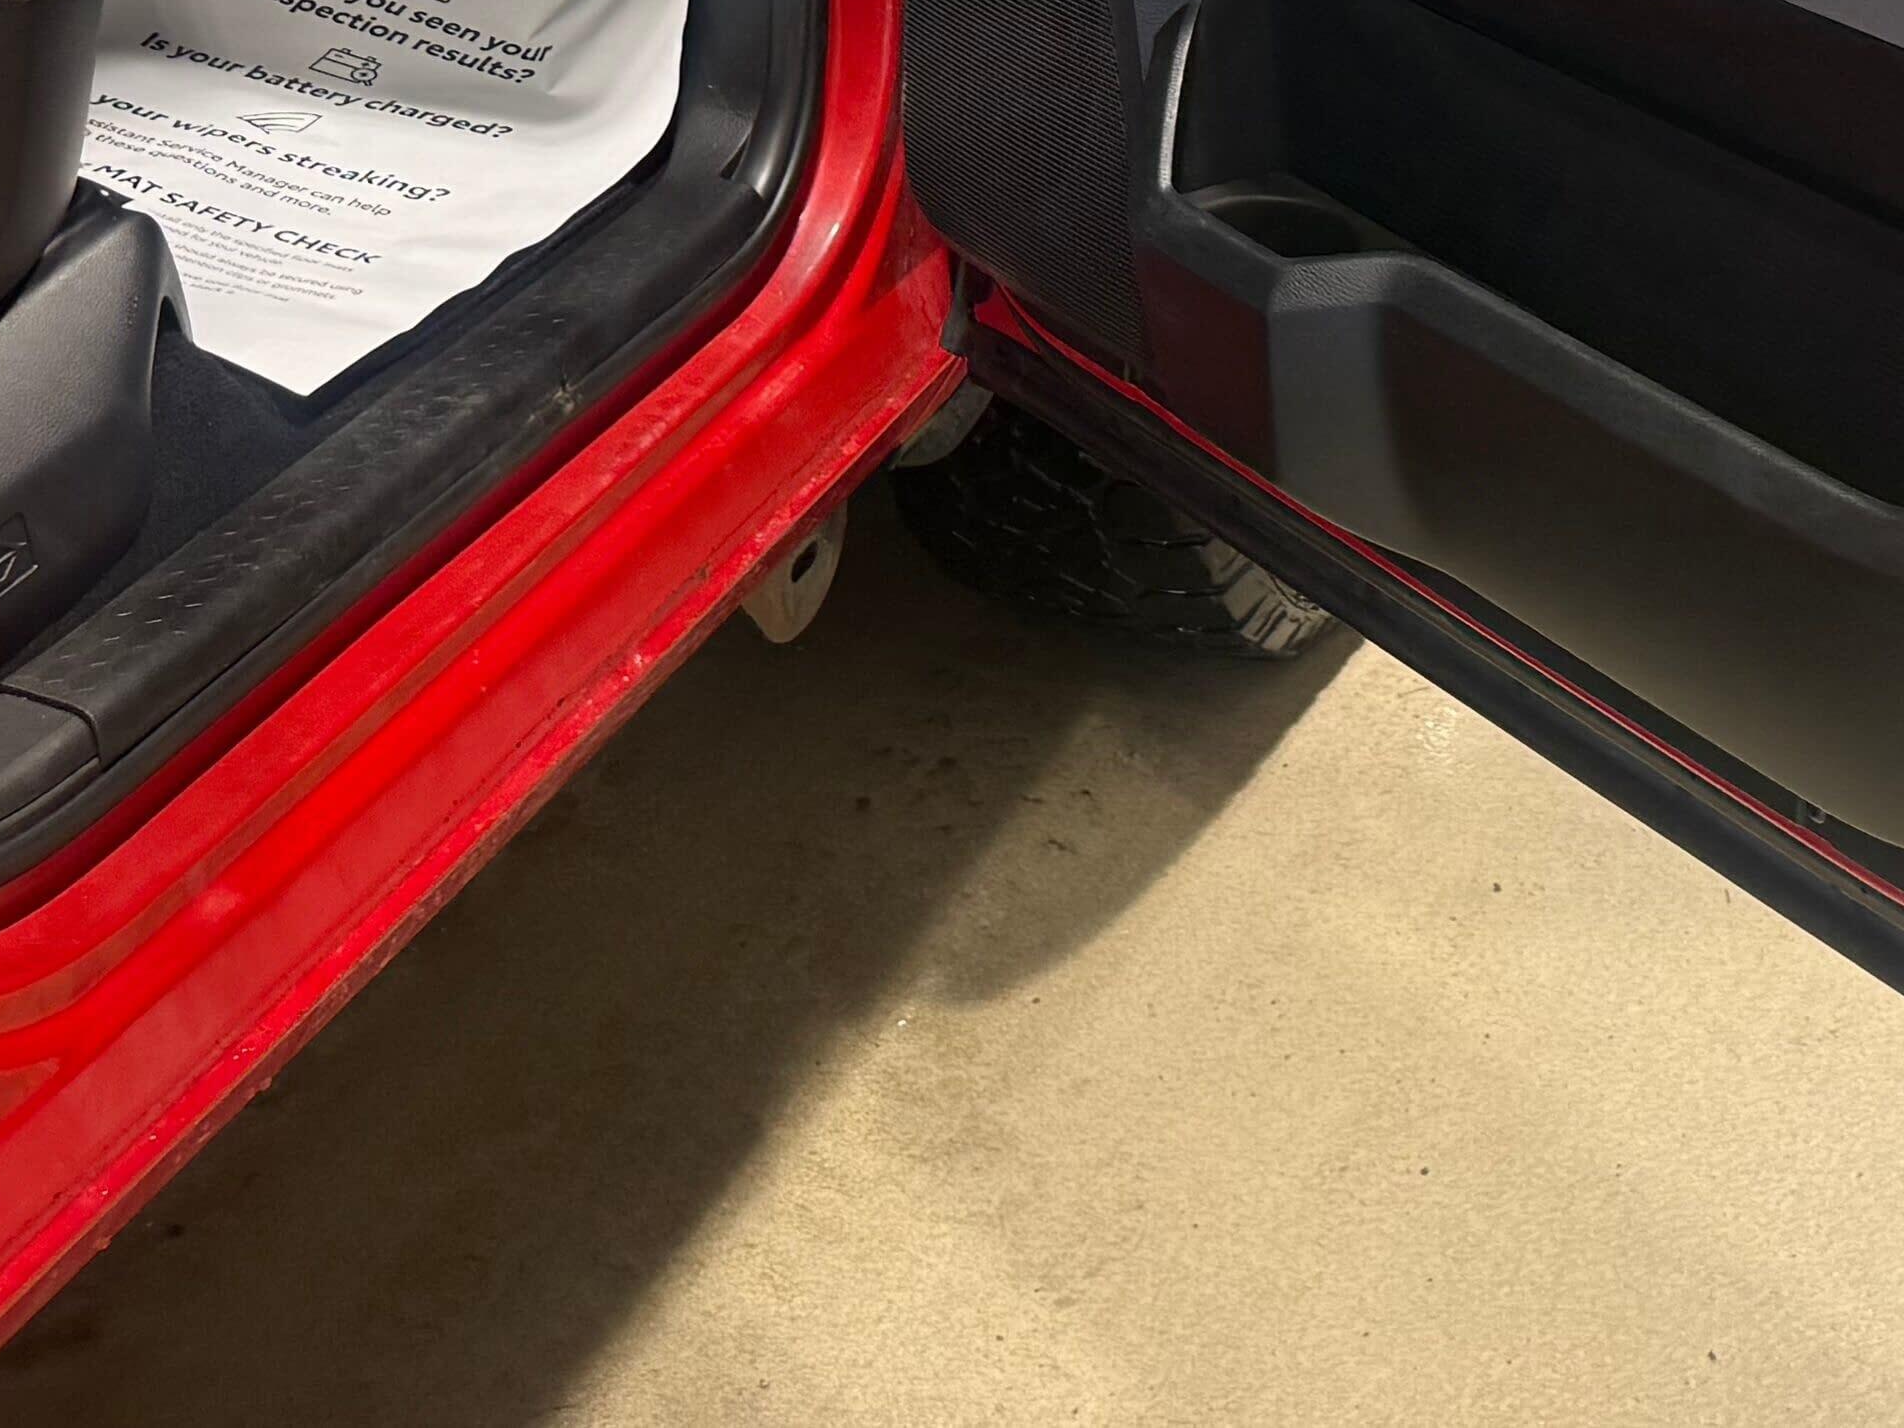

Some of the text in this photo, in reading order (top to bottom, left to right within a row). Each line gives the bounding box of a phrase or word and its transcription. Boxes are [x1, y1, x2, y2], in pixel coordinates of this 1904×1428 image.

[408, 9, 481, 42] seen
[412, 39, 535, 83] results?
[140, 32, 513, 138] Is your battery charged?
[89, 94, 451, 202] your wipers streaking?
[95, 133, 332, 216] these questions and more.
[156, 138, 224, 162] Service
[225, 160, 308, 191] Manager
[310, 190, 345, 205] can
[347, 198, 392, 217] help
[93, 164, 384, 264] MAT SAFETY CHECK
